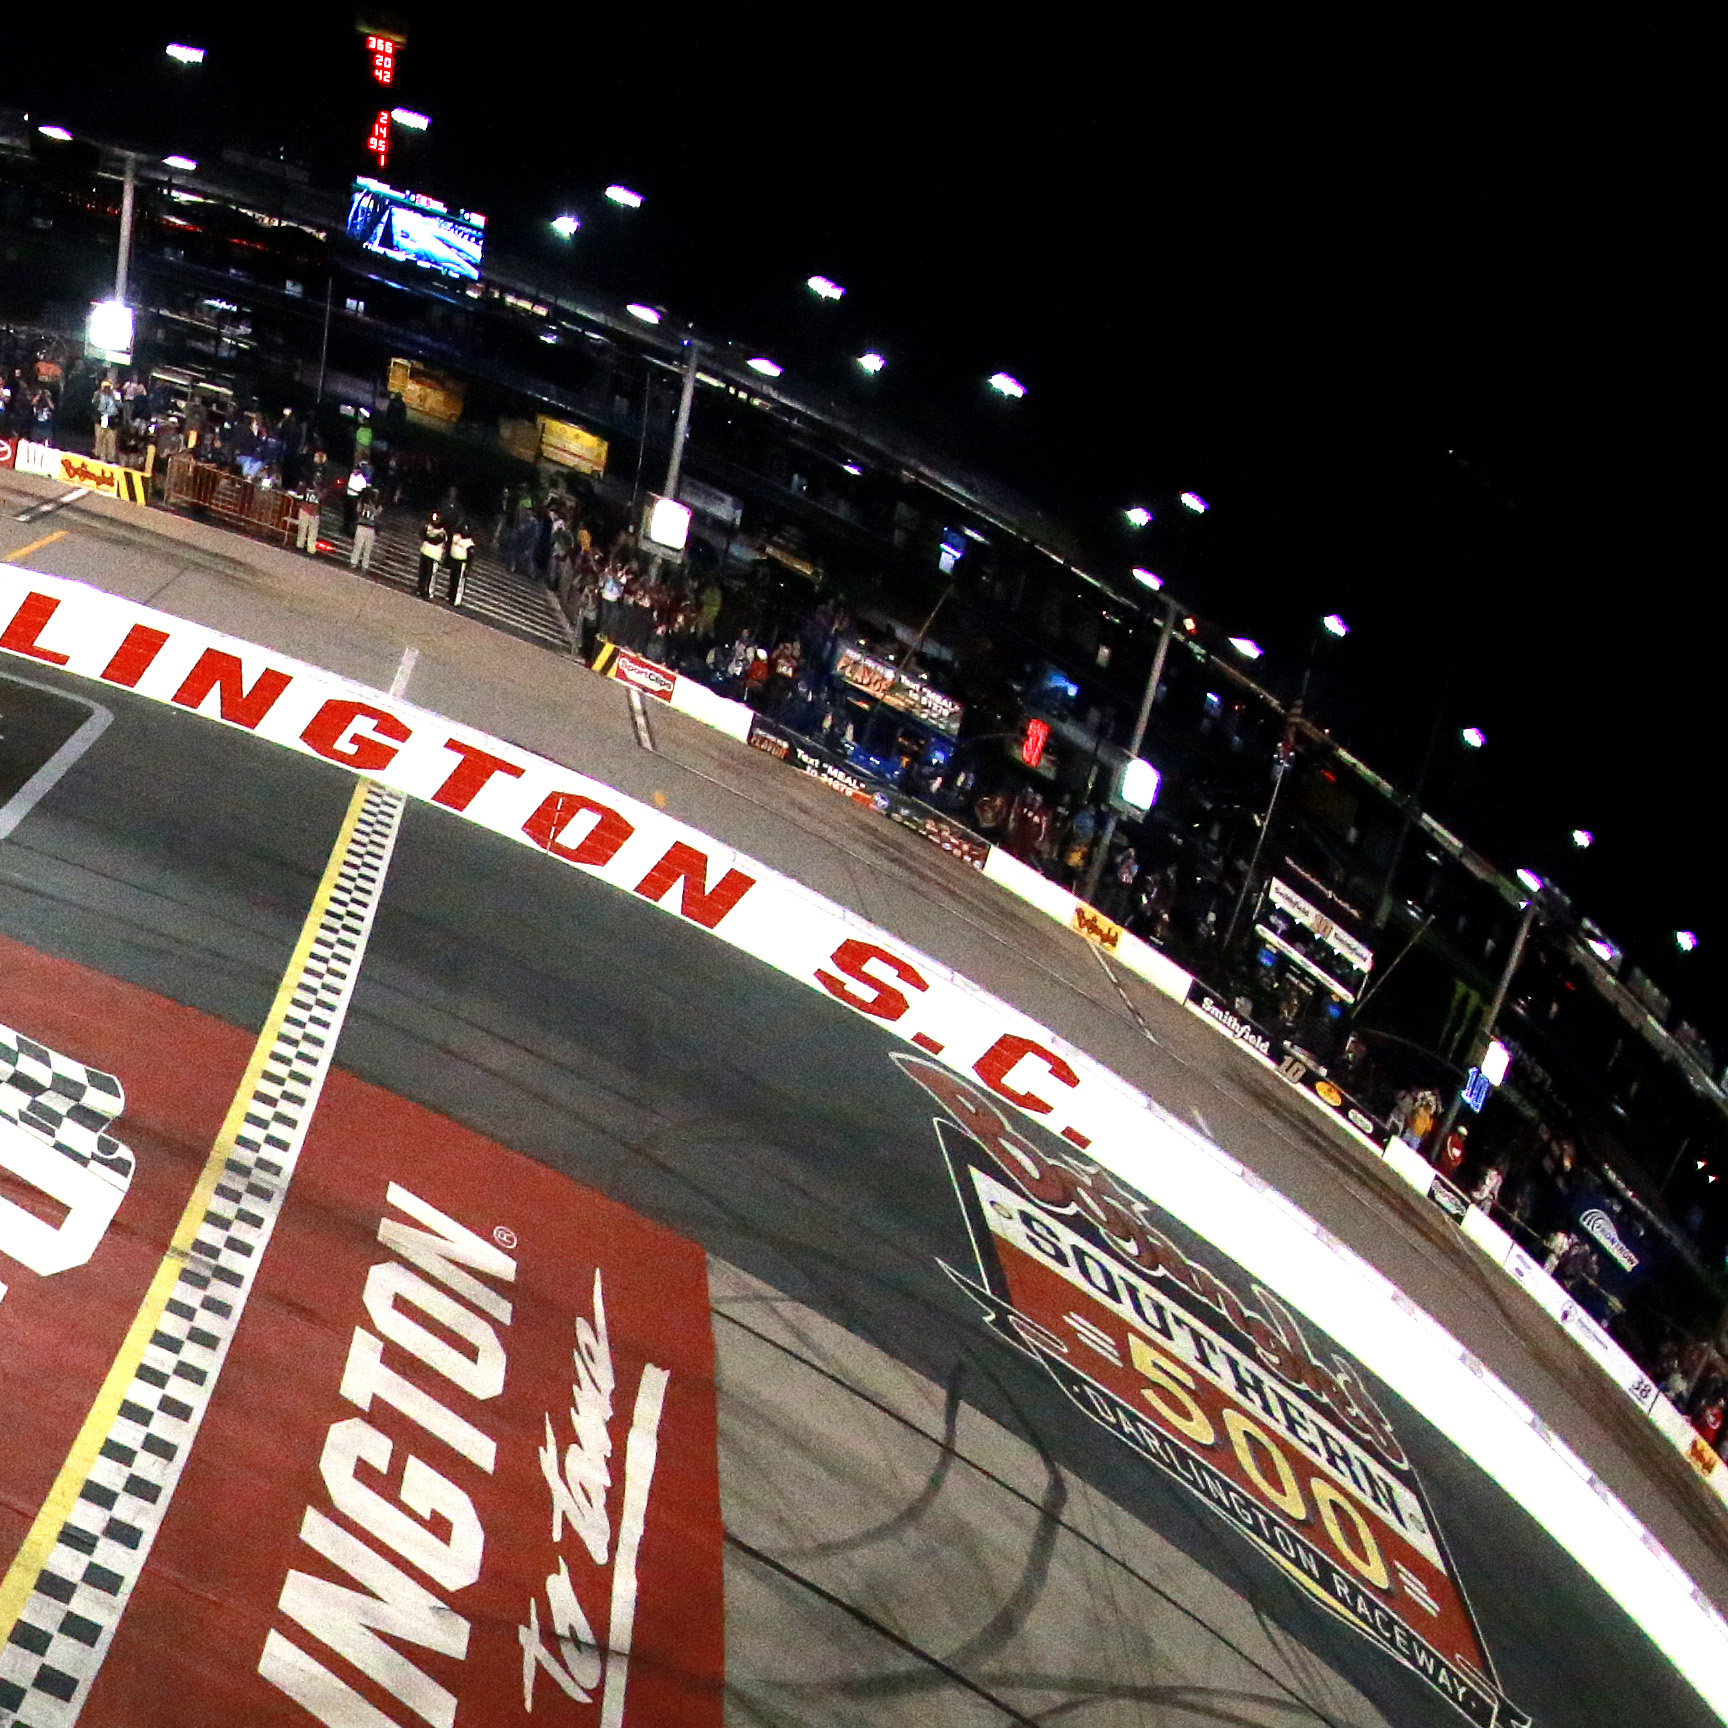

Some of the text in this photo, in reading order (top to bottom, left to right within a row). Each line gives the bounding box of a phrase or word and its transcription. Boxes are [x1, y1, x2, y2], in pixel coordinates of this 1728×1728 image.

[368, 36, 393, 54] 366
[374, 68, 391, 83] 42
[375, 54, 392, 69] 20
[380, 111, 388, 124] 2
[1201, 995, 1271, 1056] Smithfield
[1279, 1054, 1307, 1084] 10
[1018, 1208, 1411, 1531] SOUTHERN
[1126, 1331, 1388, 1590] 500
[1090, 1383, 1472, 1702] DARLINGTON RACEWAY
